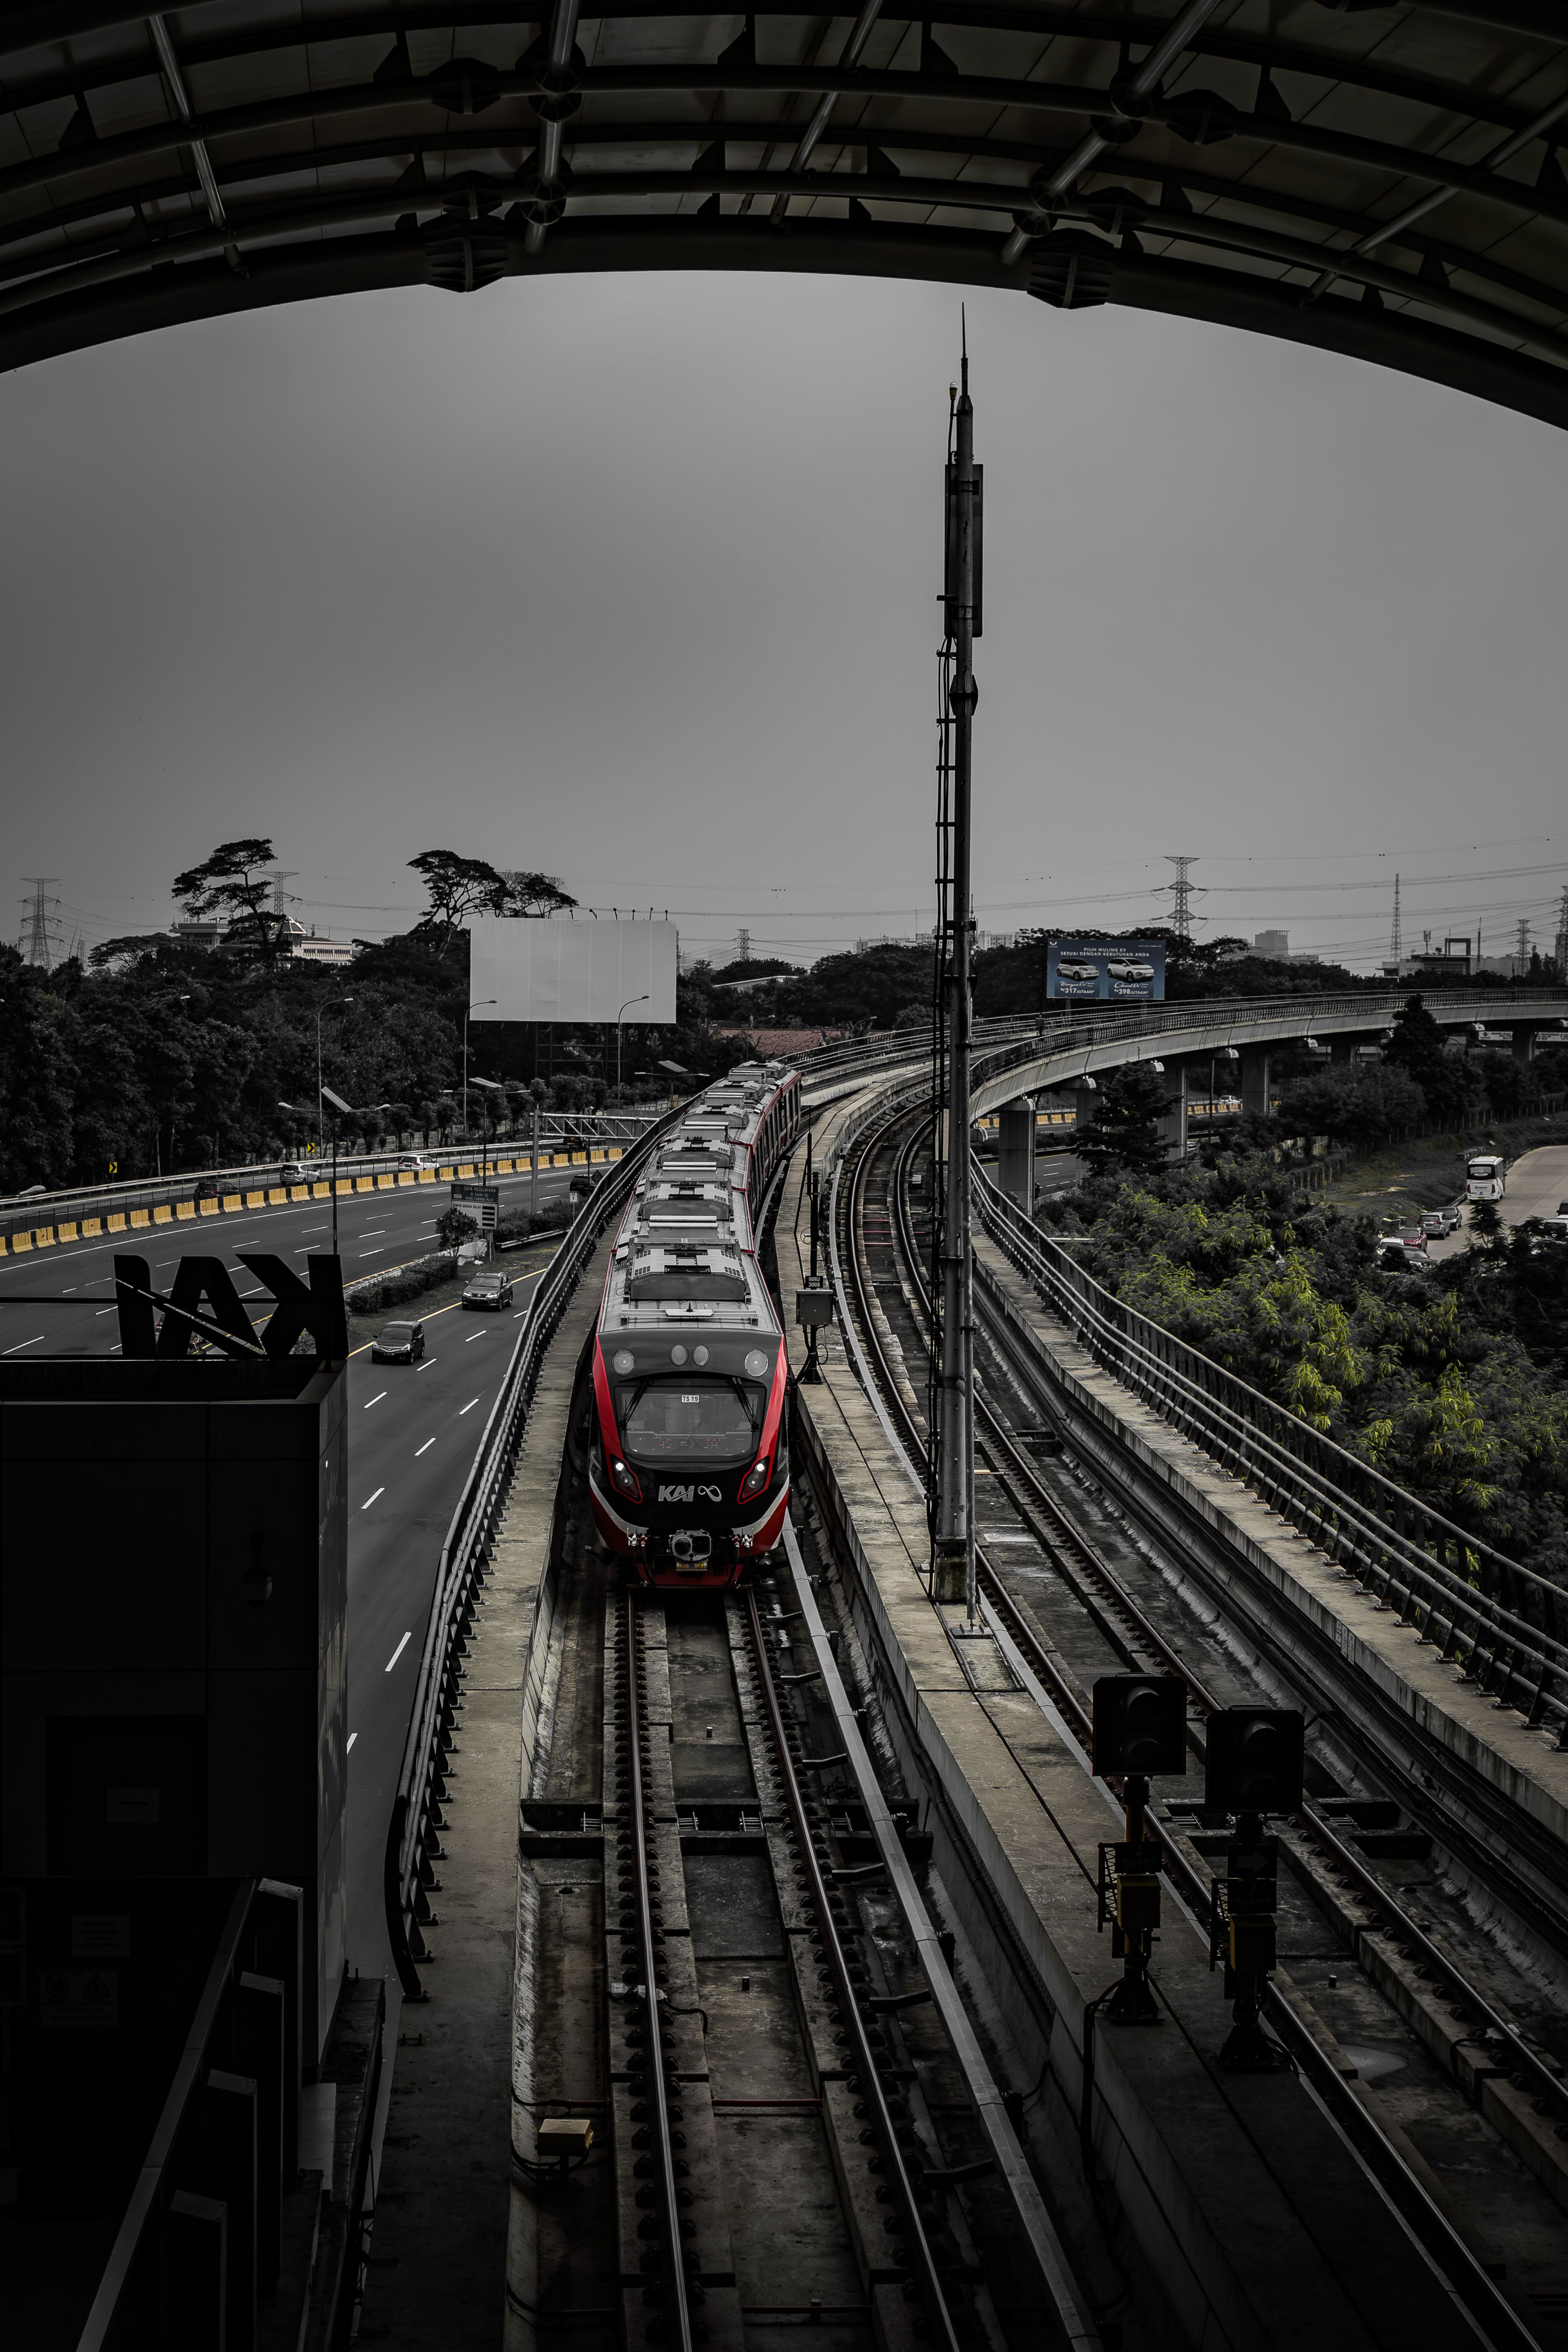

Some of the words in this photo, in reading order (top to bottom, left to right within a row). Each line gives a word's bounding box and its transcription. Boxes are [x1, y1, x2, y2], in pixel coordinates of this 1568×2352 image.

[658, 1486, 694, 1502] KAI
[1134, 1845, 1142, 1856] J
[1121, 1858, 1157, 1870] 30101
[1248, 1884, 1256, 1897] J
[1232, 1898, 1271, 1911] 30102
